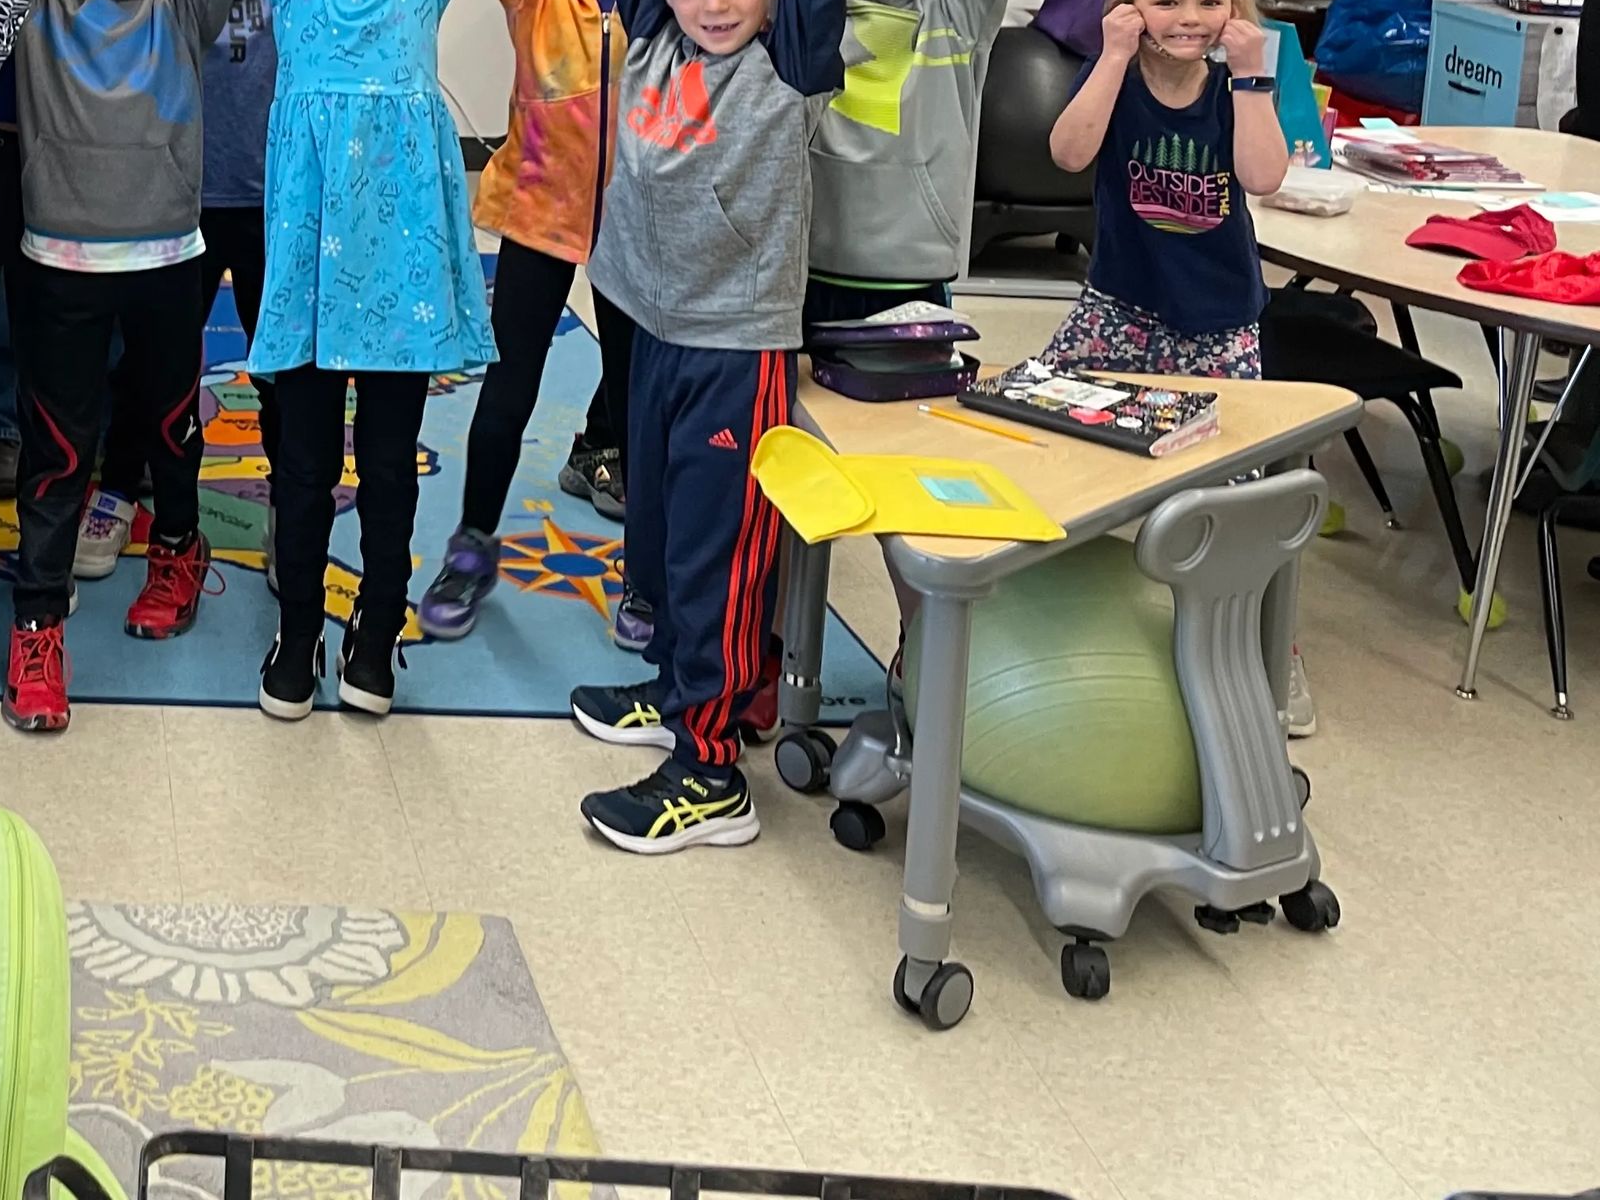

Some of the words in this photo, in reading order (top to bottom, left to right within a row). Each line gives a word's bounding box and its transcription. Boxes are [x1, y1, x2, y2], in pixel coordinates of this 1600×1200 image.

[1445, 46, 1502, 90] dream
[1128, 159, 1219, 195] OUTSIDE
[1218, 173, 1230, 189] IS
[1129, 181, 1219, 217] BESTSIDE
[1219, 196, 1230, 216] THE
